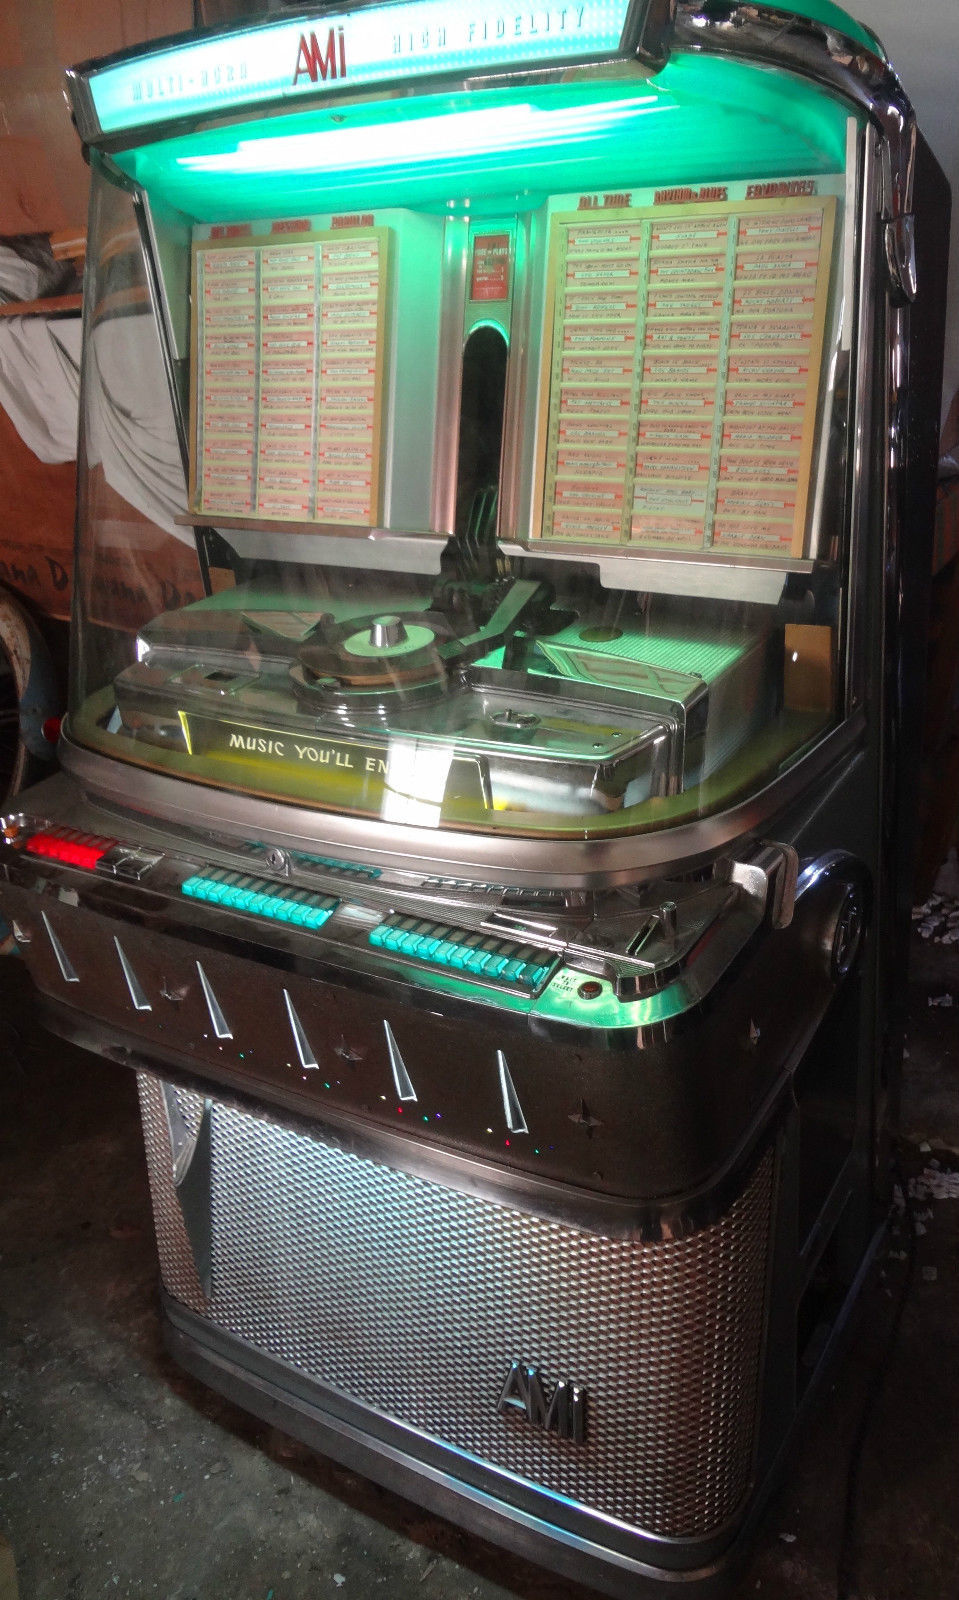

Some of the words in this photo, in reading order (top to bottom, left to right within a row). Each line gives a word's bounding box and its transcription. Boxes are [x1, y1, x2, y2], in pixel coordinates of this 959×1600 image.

[468, 6, 585, 43] FIDELITY
[229, 733, 285, 757] MUSIC
[294, 744, 354, 769] YOU'LL
